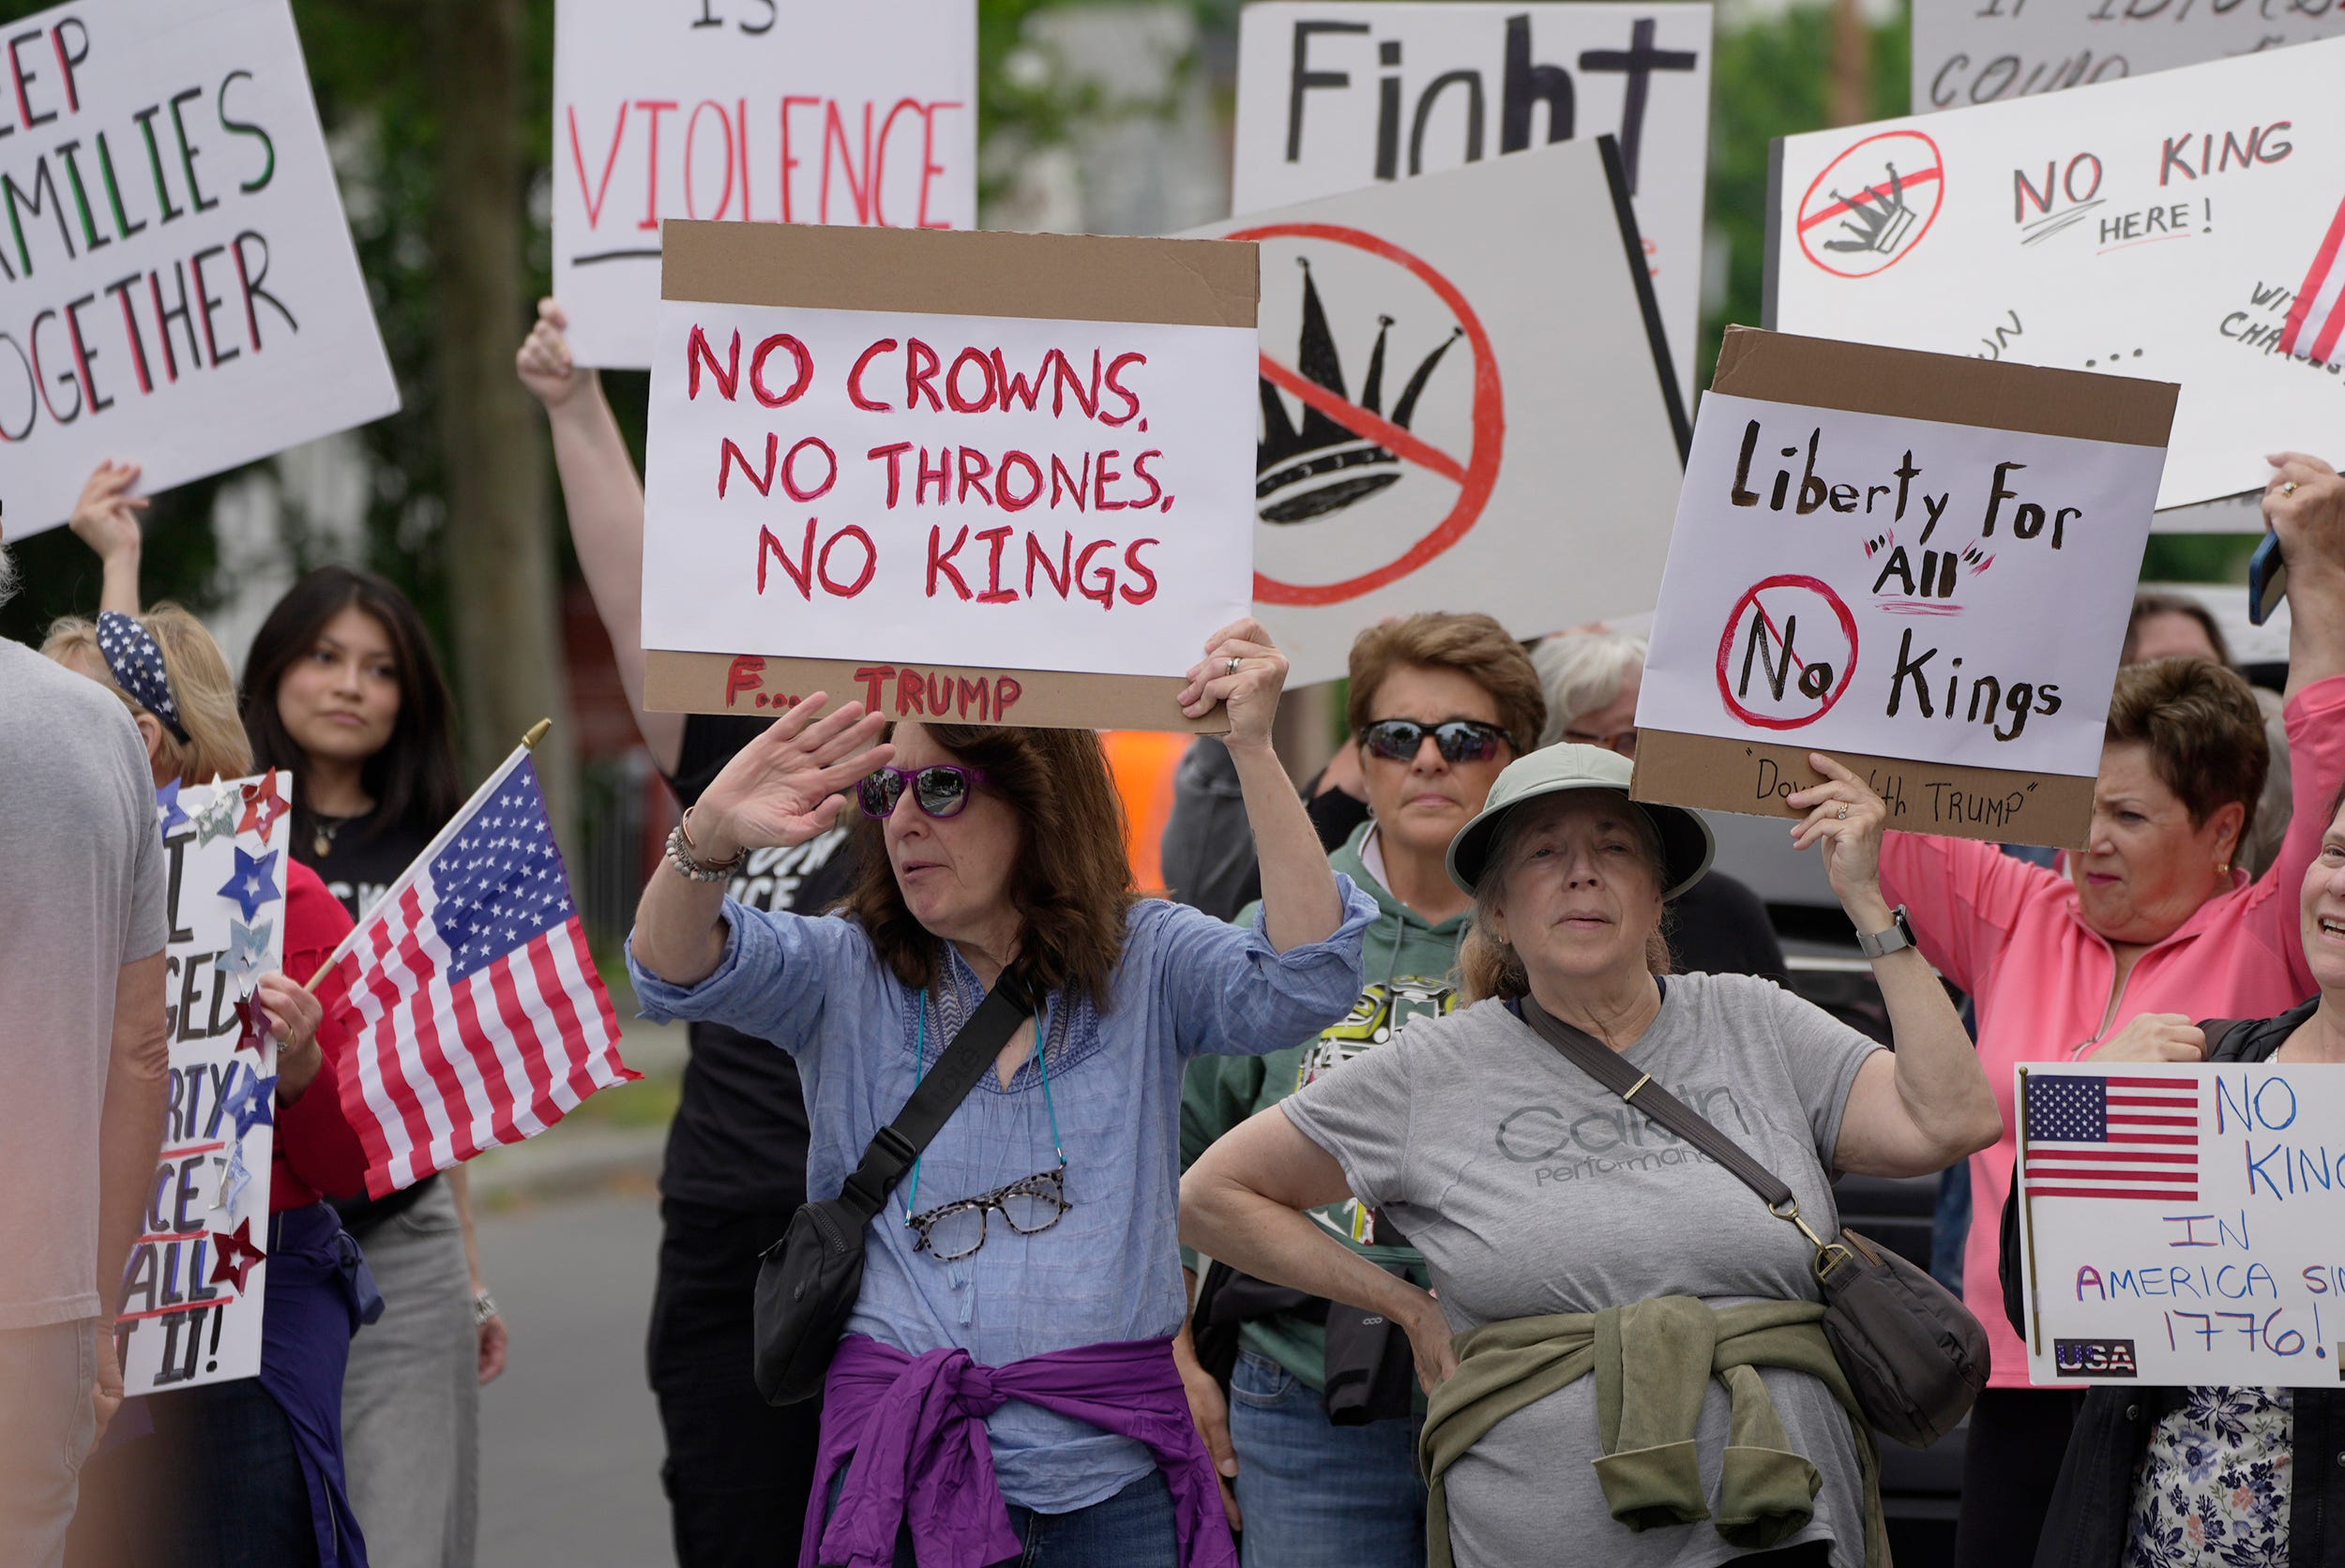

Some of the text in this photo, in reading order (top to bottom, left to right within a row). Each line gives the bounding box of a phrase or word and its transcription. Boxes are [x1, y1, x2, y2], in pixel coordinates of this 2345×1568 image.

[0, 17, 89, 138] EP
[567, 97, 964, 231] VIOLENCE
[2014, 120, 2292, 224] NO KING
[687, 323, 813, 408] NO
[719, 432, 838, 503] NO
[1732, 419, 2082, 550] Liberty For
[757, 518, 1160, 611] NO KINGS
[853, 665, 1023, 723] TRUMP
[1738, 609, 2063, 742] No Kings
[1925, 781, 2038, 828] TRUMP"
[2216, 1073, 2297, 1135] NO
[142, 1155, 205, 1235] CE
[2162, 1209, 2249, 1250] IN
[116, 1240, 218, 1315] ALL
[2077, 1263, 2345, 1303] AMERICA SI
[153, 1304, 224, 1387] IT!
[2057, 1344, 2136, 1373] USA
[2164, 1301, 2327, 1359] 1776!
